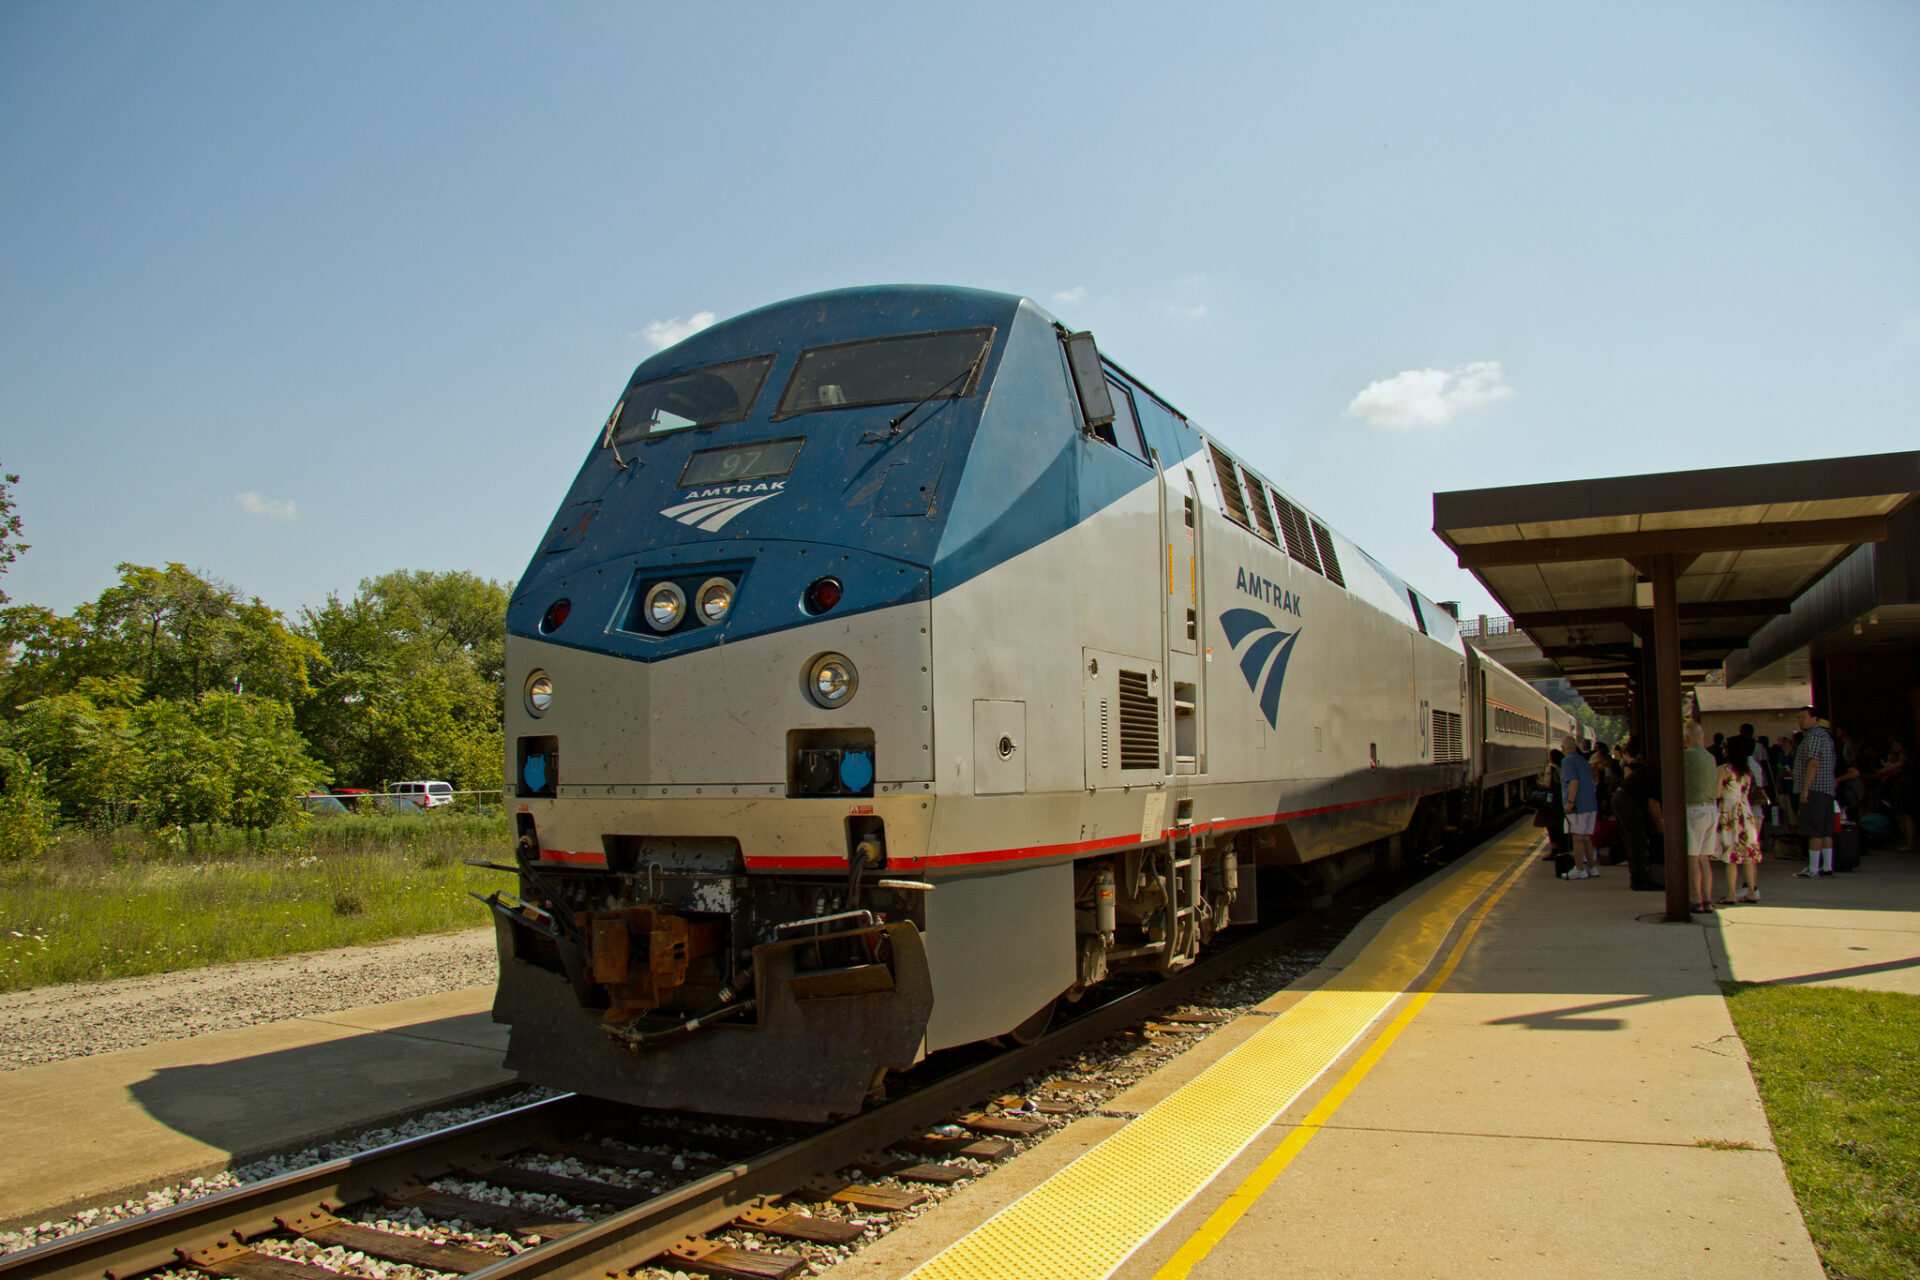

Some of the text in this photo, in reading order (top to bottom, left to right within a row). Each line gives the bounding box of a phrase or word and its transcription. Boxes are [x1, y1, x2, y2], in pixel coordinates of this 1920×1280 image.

[721, 451, 762, 477] 97
[685, 481, 787, 499] AMTRAK
[1236, 566, 1301, 617] AMTRAK
